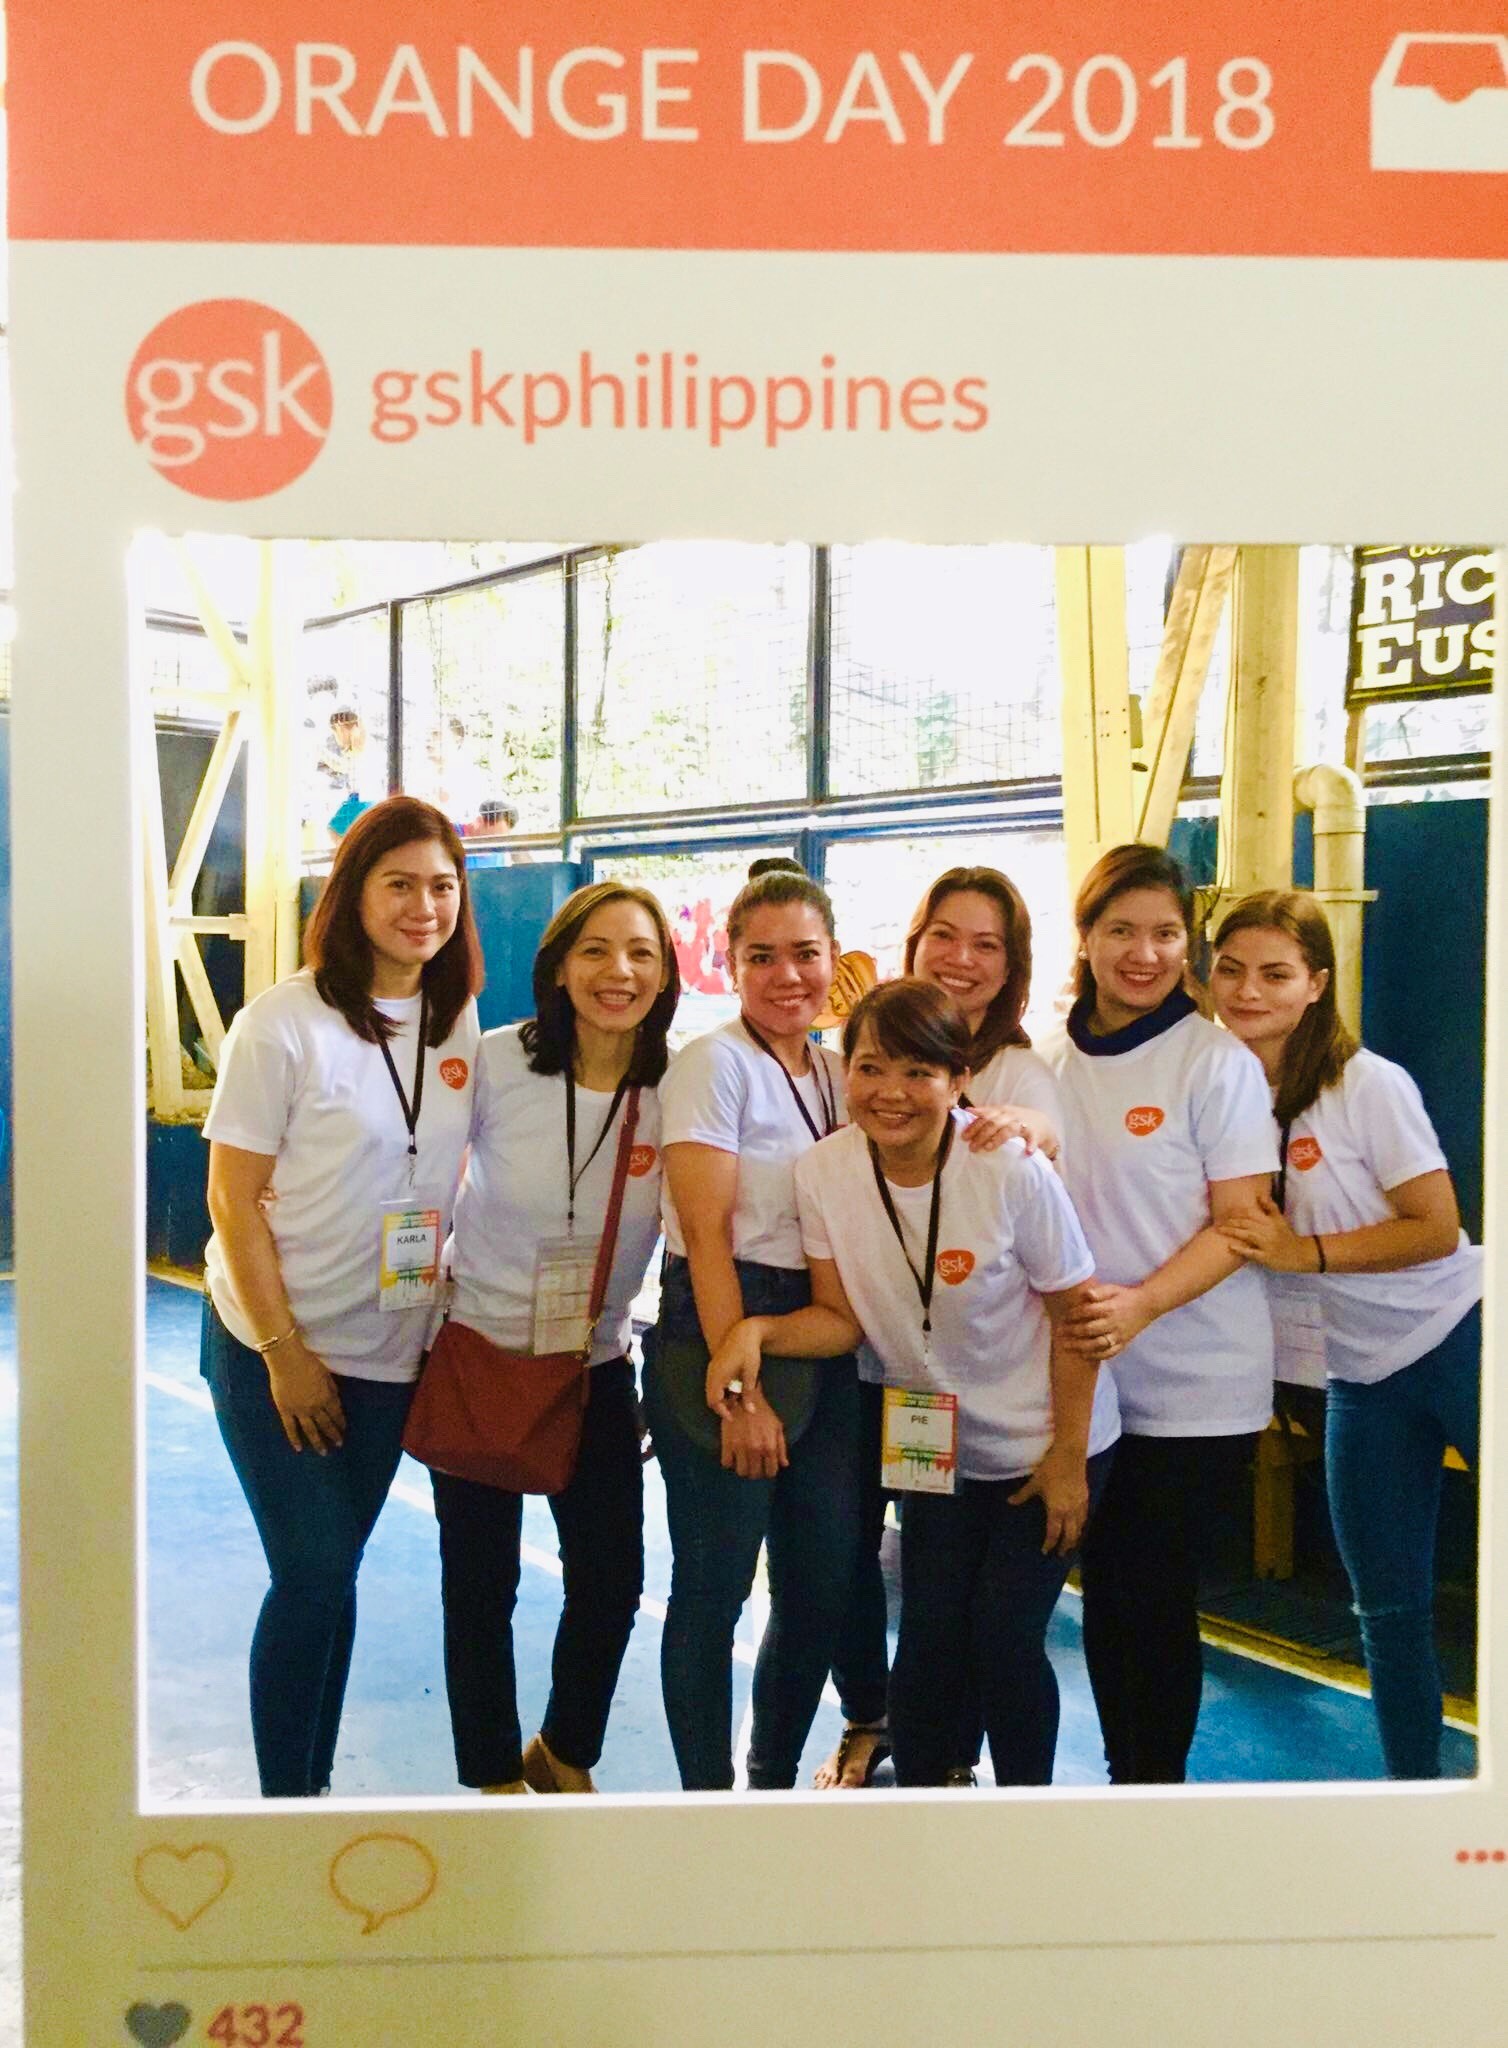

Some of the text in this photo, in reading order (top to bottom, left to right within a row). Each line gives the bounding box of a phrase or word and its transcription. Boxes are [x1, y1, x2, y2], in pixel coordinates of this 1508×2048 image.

[189, 40, 1276, 151] ORANGE DAY 2018
[134, 330, 330, 467] gsk
[369, 348, 990, 448] gskphilippines
[1127, 1110, 1158, 1129] gsk
[1290, 1142, 1318, 1164] gsk
[396, 1233, 428, 1245] KARLA
[939, 1255, 969, 1278] gsk
[910, 1414, 929, 1425] PIE
[207, 2003, 304, 2048] 432
